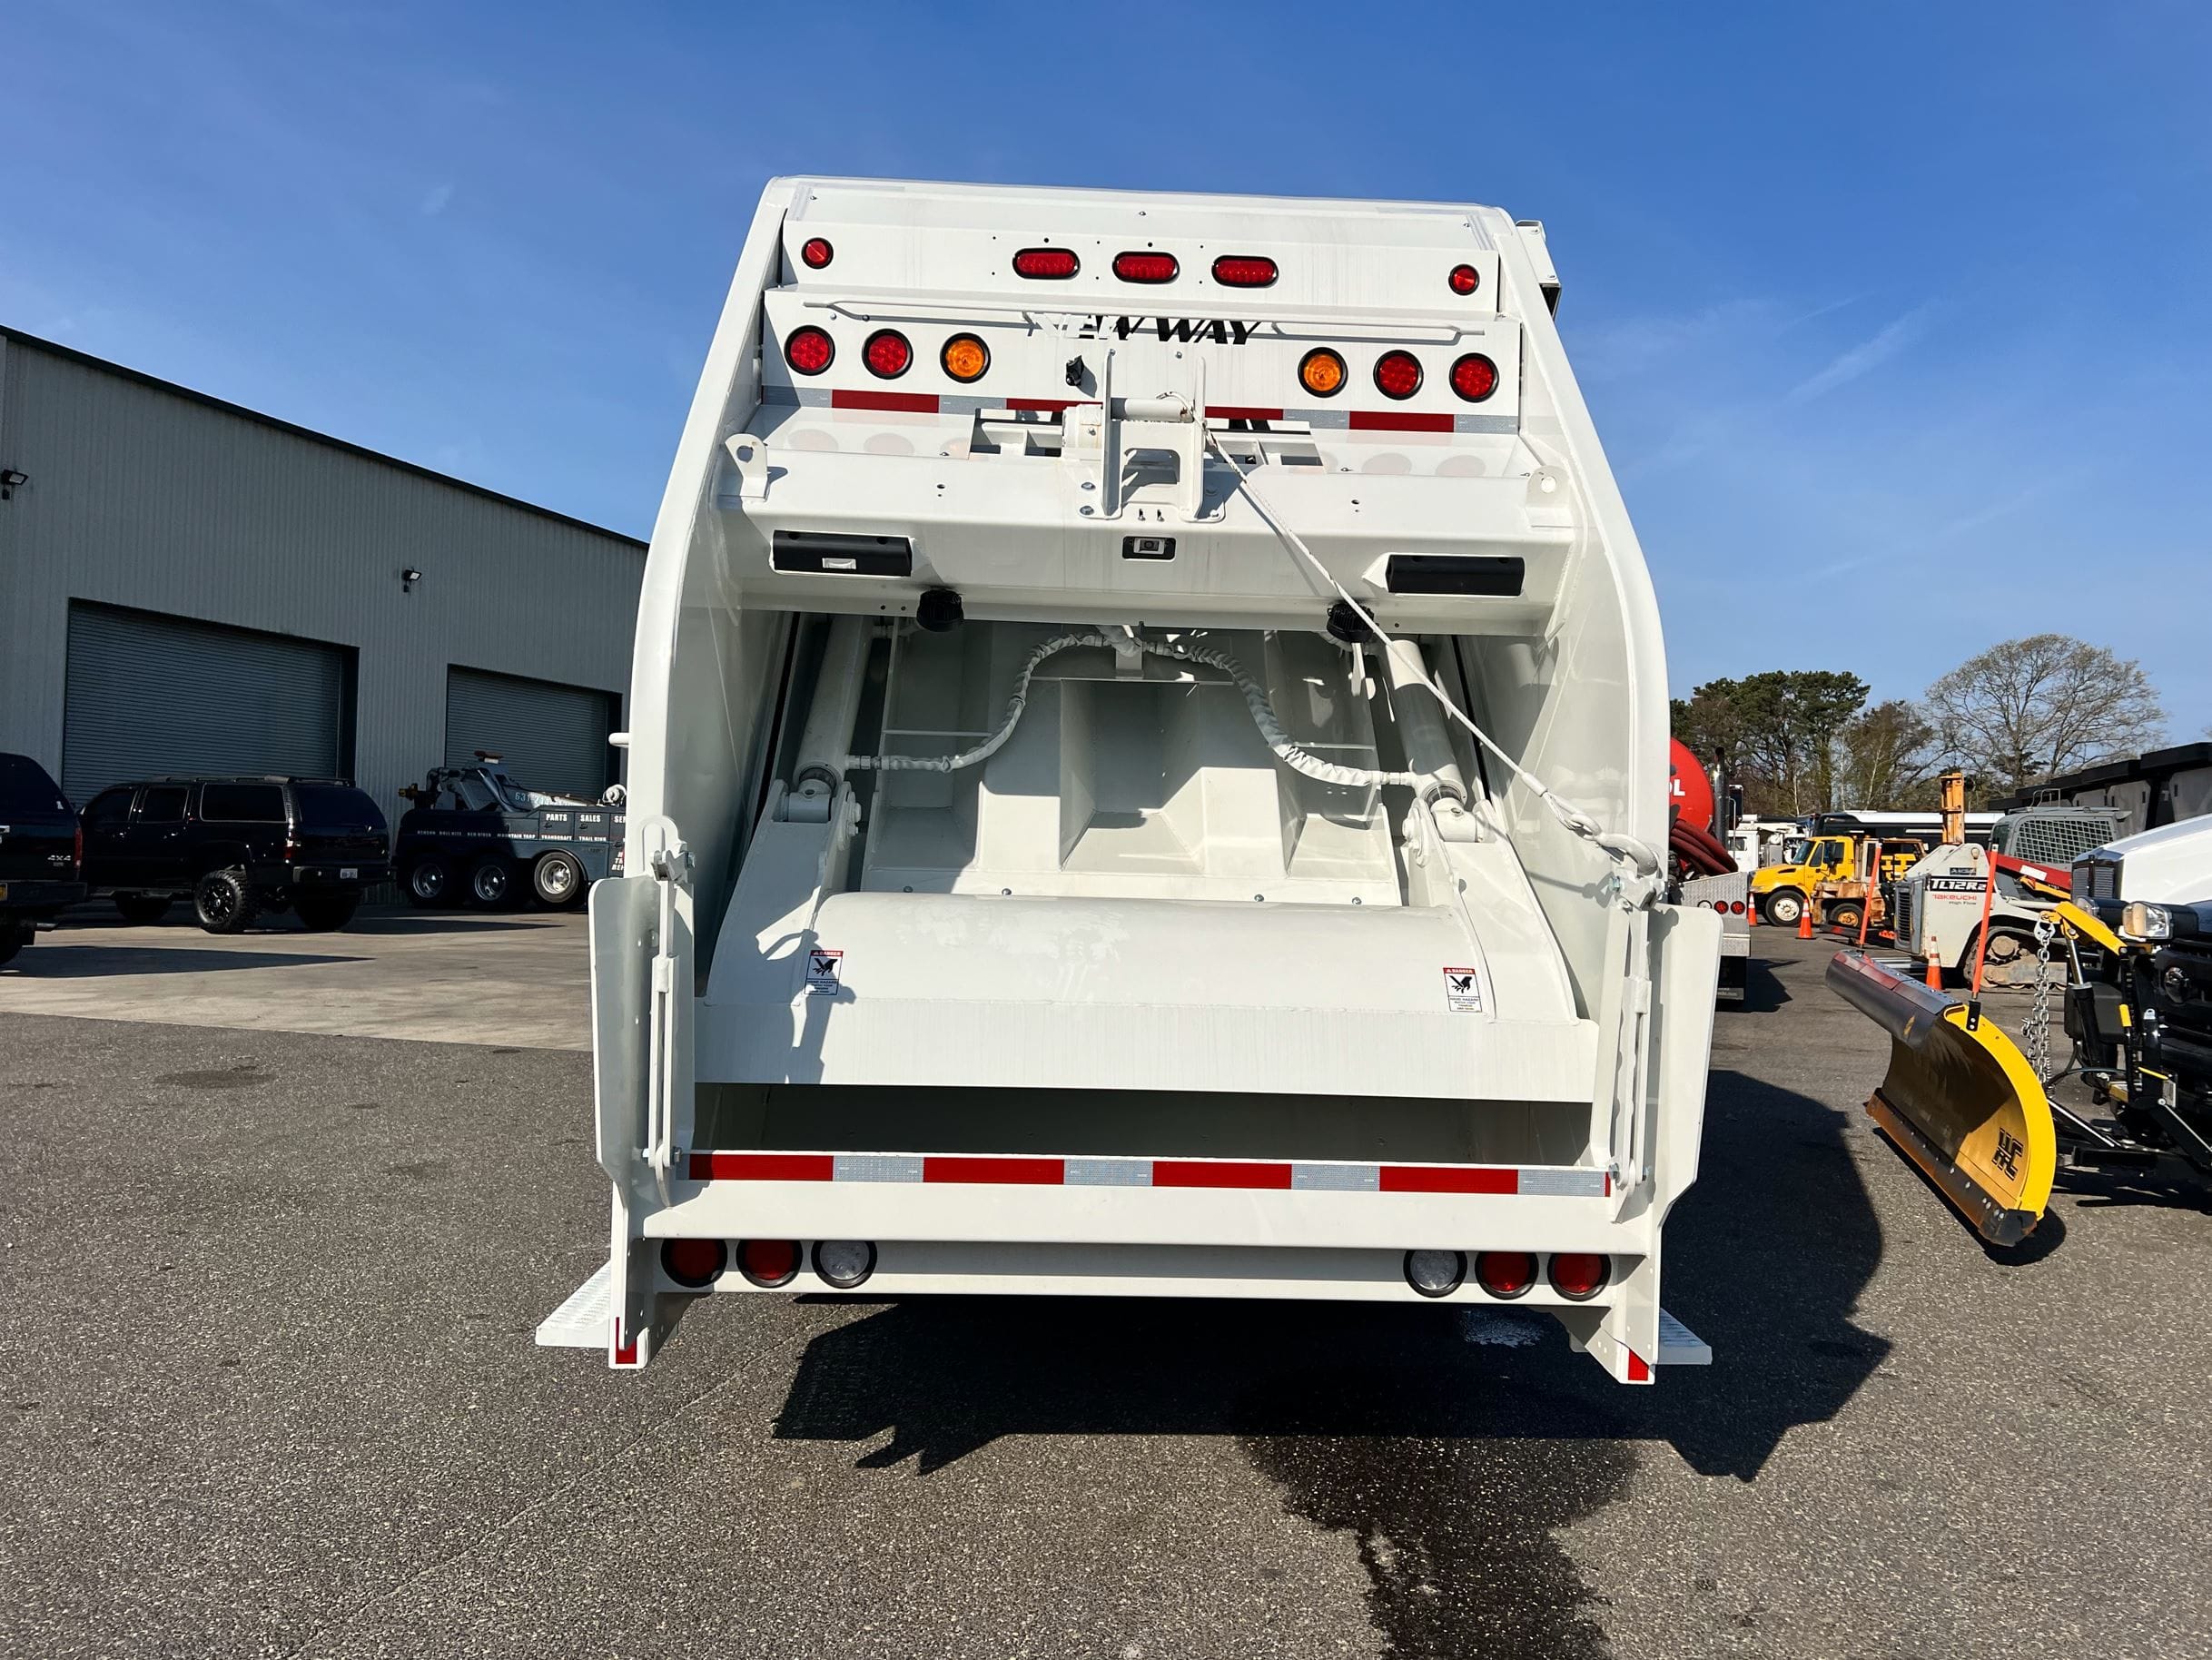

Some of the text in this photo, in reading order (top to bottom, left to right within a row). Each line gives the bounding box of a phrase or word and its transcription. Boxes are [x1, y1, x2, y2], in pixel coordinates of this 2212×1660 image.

[1155, 317, 1262, 346] WAY
[546, 814, 568, 822] PARTS
[580, 815, 601, 823] SALES
